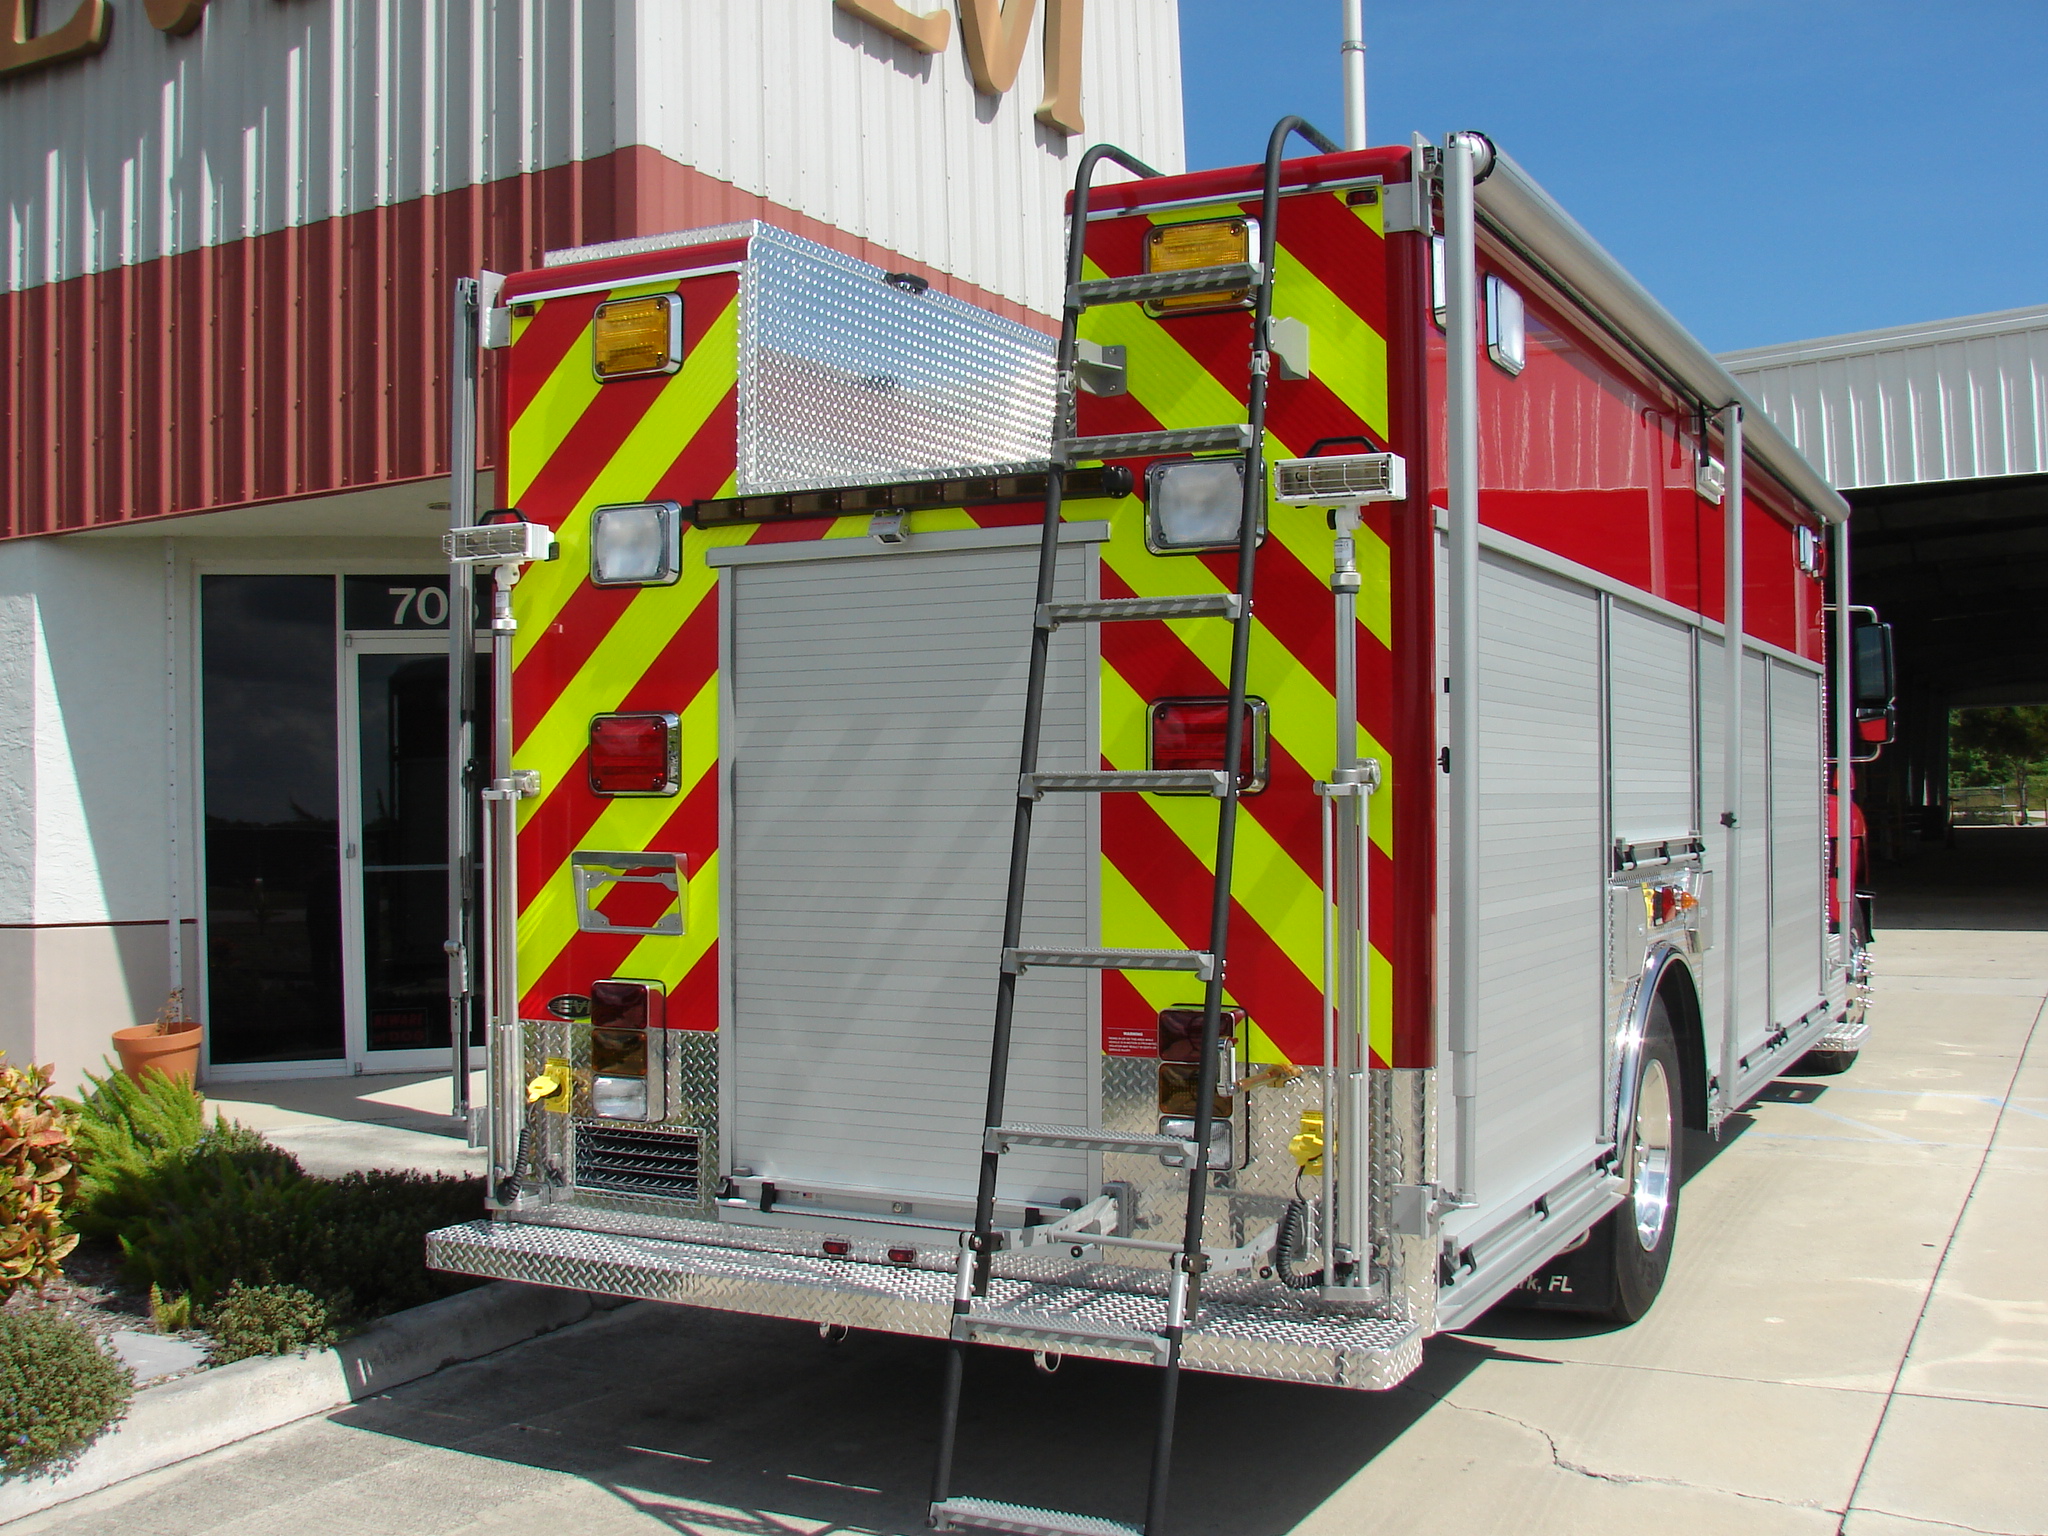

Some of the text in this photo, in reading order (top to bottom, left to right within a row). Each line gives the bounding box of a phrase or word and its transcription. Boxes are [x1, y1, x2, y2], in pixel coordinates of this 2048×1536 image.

[388, 586, 480, 625] 70
[1515, 1274, 1574, 1293] rk, FL
